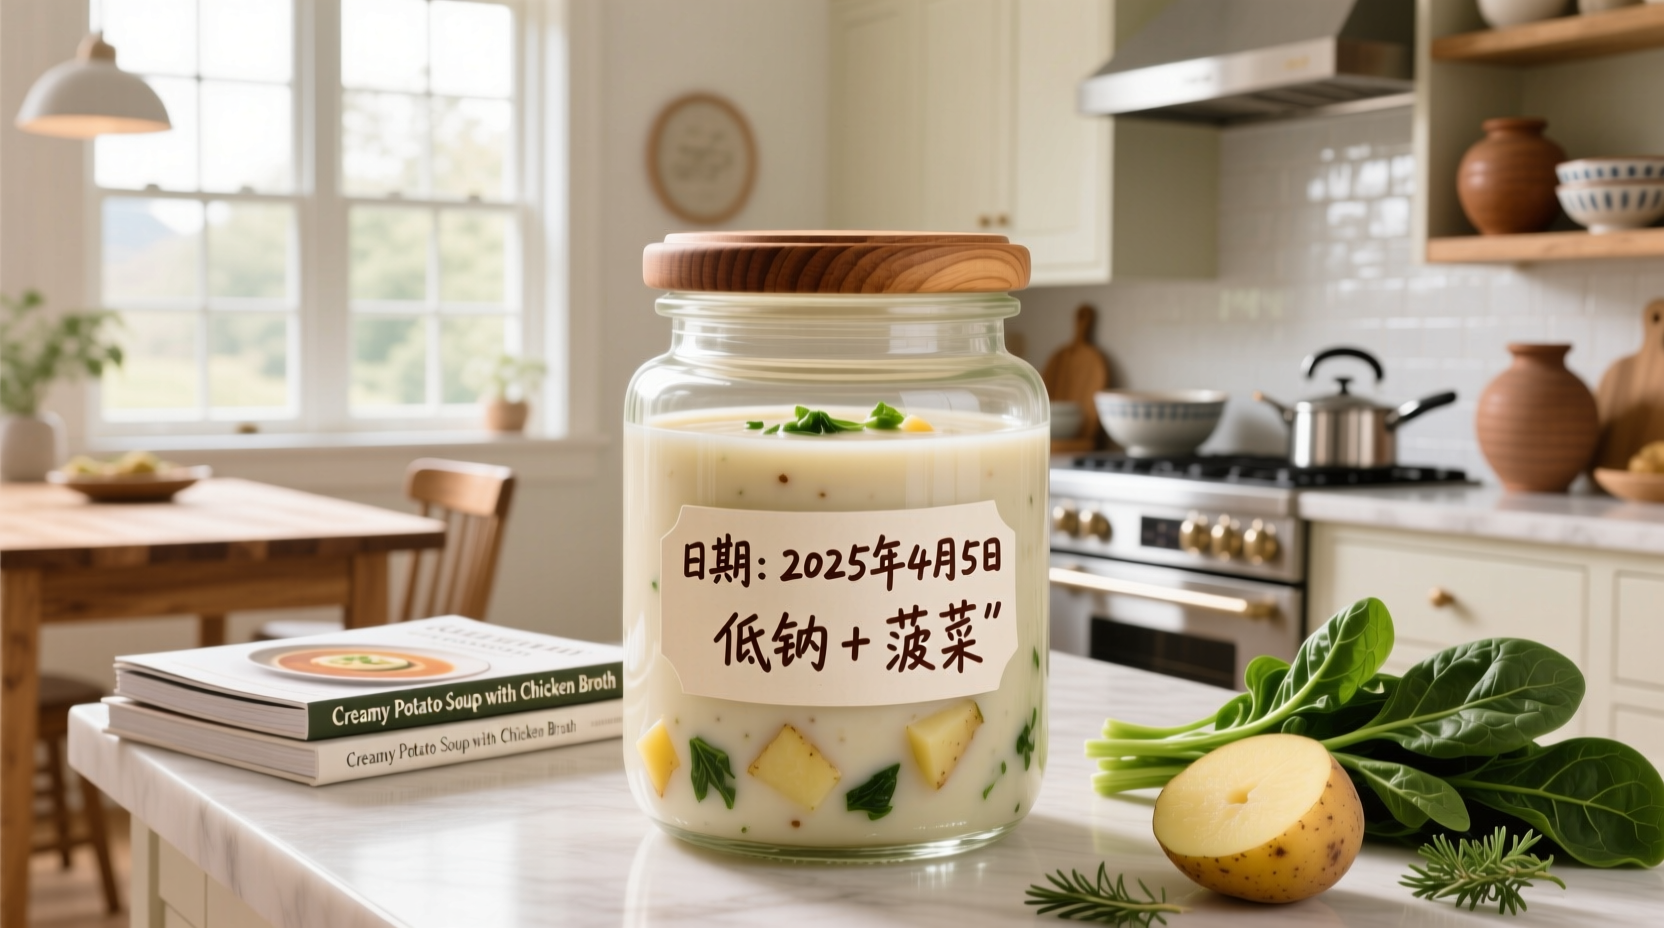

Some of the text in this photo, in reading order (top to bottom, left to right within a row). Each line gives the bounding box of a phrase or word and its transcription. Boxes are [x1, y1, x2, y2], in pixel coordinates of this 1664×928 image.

[683, 533, 1002, 591] 日期: 2025年4月5日
[713, 611, 828, 673] 低钠
[841, 626, 871, 662] +
[332, 670, 617, 726] Creamy Potato Soup with Chicken Broth
[346, 749, 396, 768] Creamy
[399, 742, 437, 759] Potato
[440, 735, 470, 754] Soup
